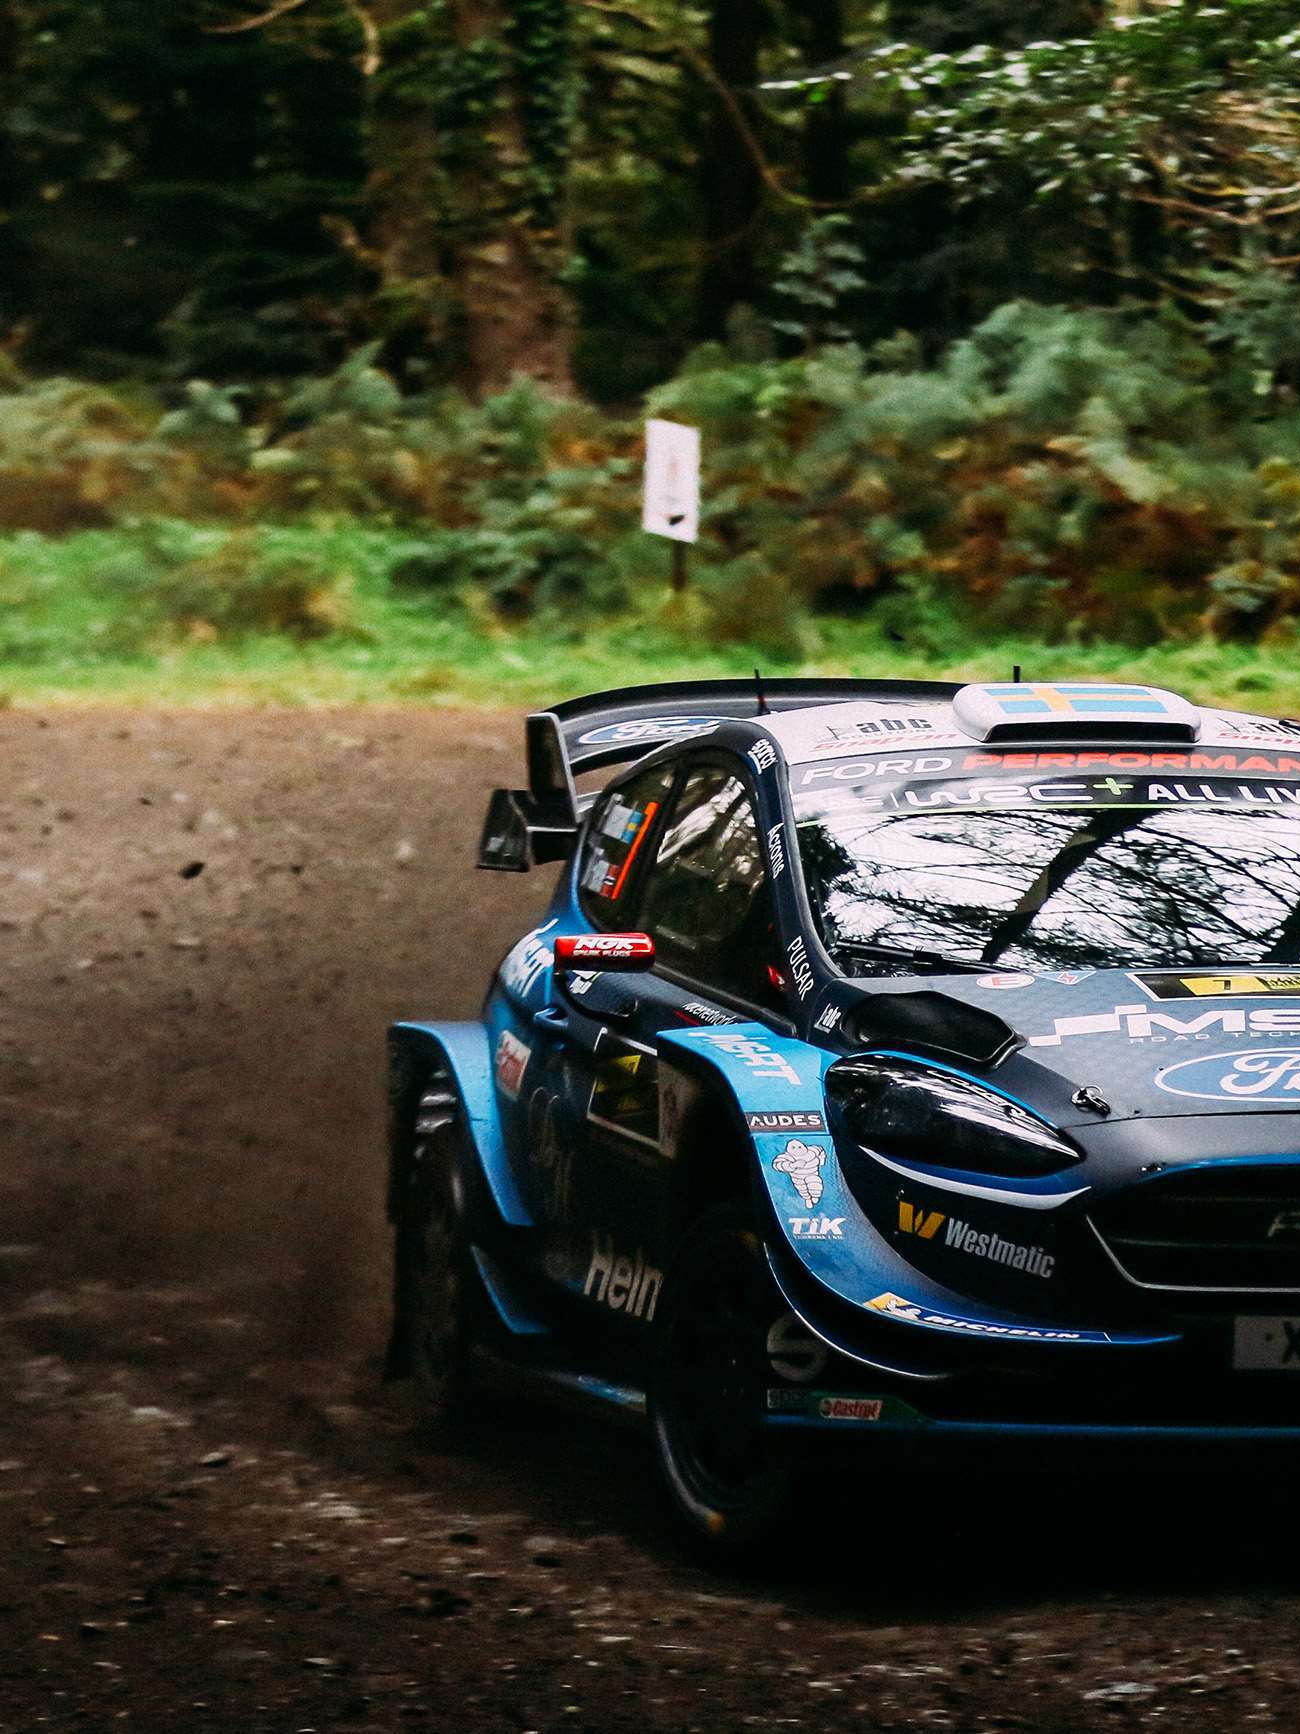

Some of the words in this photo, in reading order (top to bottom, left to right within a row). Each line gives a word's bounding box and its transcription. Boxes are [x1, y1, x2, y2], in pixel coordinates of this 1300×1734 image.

[800, 757, 953, 785] FORD
[1148, 783, 1232, 802] ALL
[786, 936, 815, 1001] PULSAR
[1128, 1033, 1211, 1044] ROAD
[749, 1114, 821, 1127] AUDES
[944, 1217, 1056, 1280] Westmatic
[923, 1314, 1080, 1339] MICHELIN
